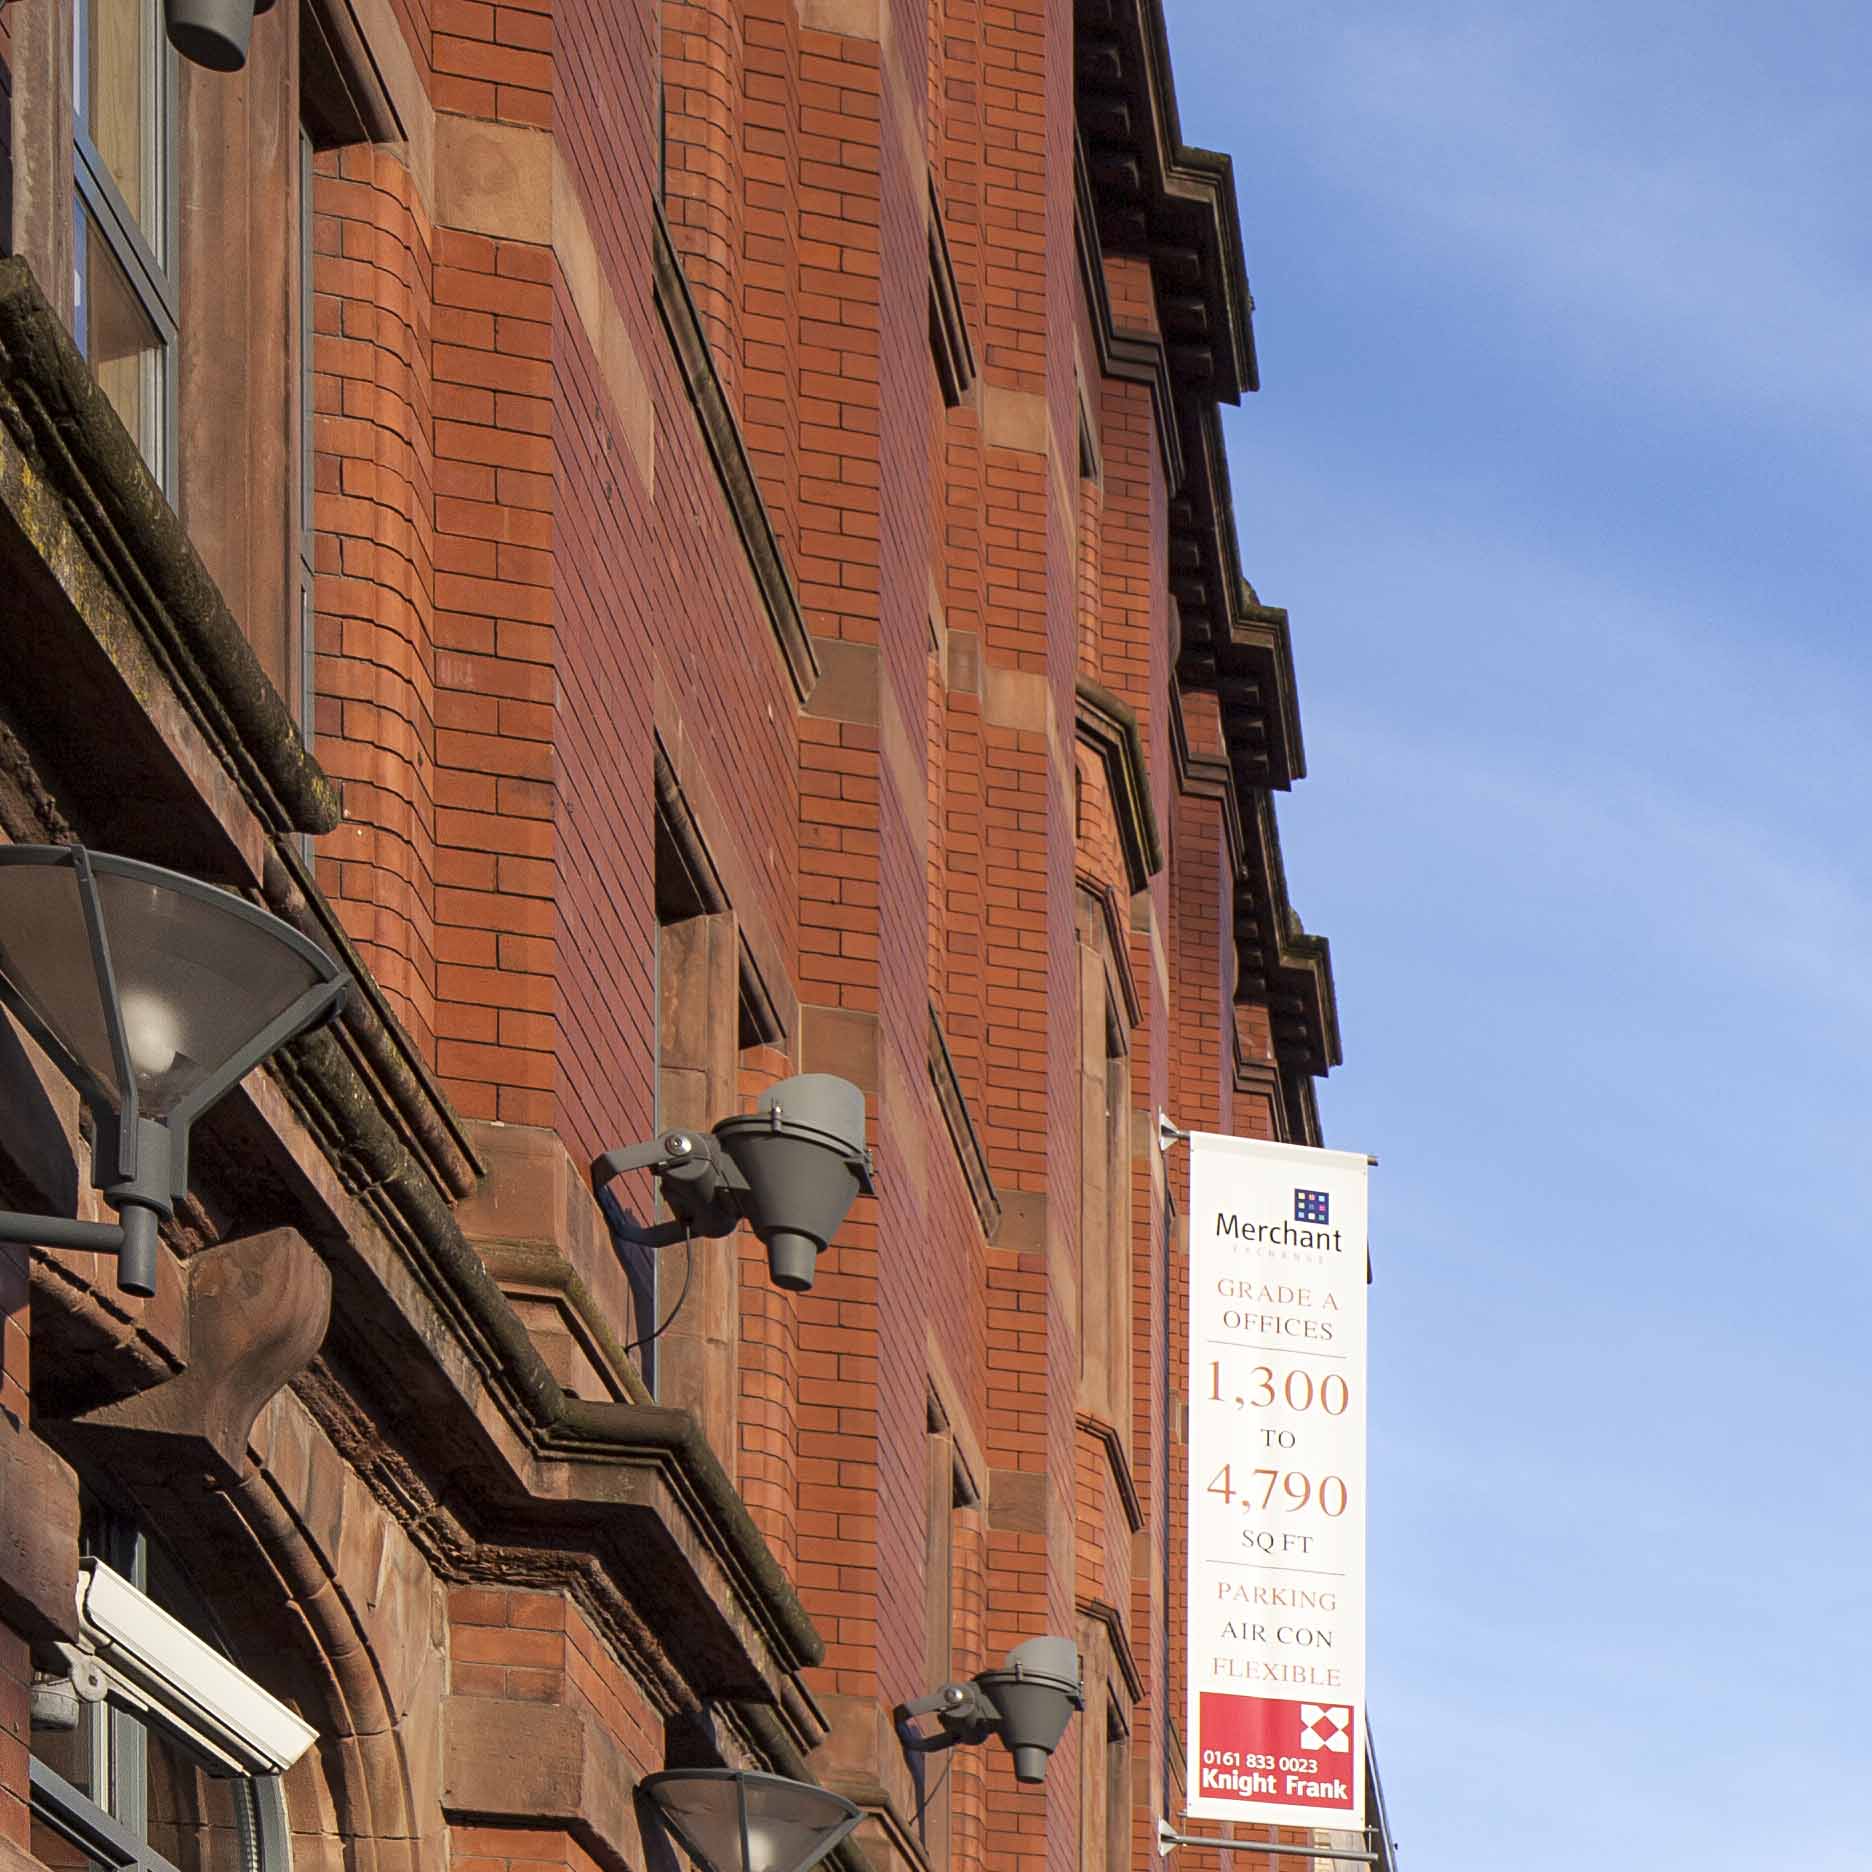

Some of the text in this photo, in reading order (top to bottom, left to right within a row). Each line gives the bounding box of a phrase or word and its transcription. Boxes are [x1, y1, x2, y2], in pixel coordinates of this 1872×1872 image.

[1216, 1212, 1342, 1252] Merchant
[1217, 1277, 1340, 1311] GRADE A
[1223, 1310, 1334, 1341] OFFICES
[1207, 1360, 1349, 1416] 1,300
[1260, 1427, 1296, 1449] TO
[1207, 1463, 1348, 1518] 4,790
[1242, 1529, 1314, 1554] SQ FT
[1217, 1582, 1336, 1612] PARKING
[1221, 1620, 1333, 1648] AIR CON
[1213, 1656, 1342, 1687] FLEXIBLE
[1203, 1750, 1318, 1774] 0161 833 0023
[1202, 1767, 1348, 1800] Knight Frank
